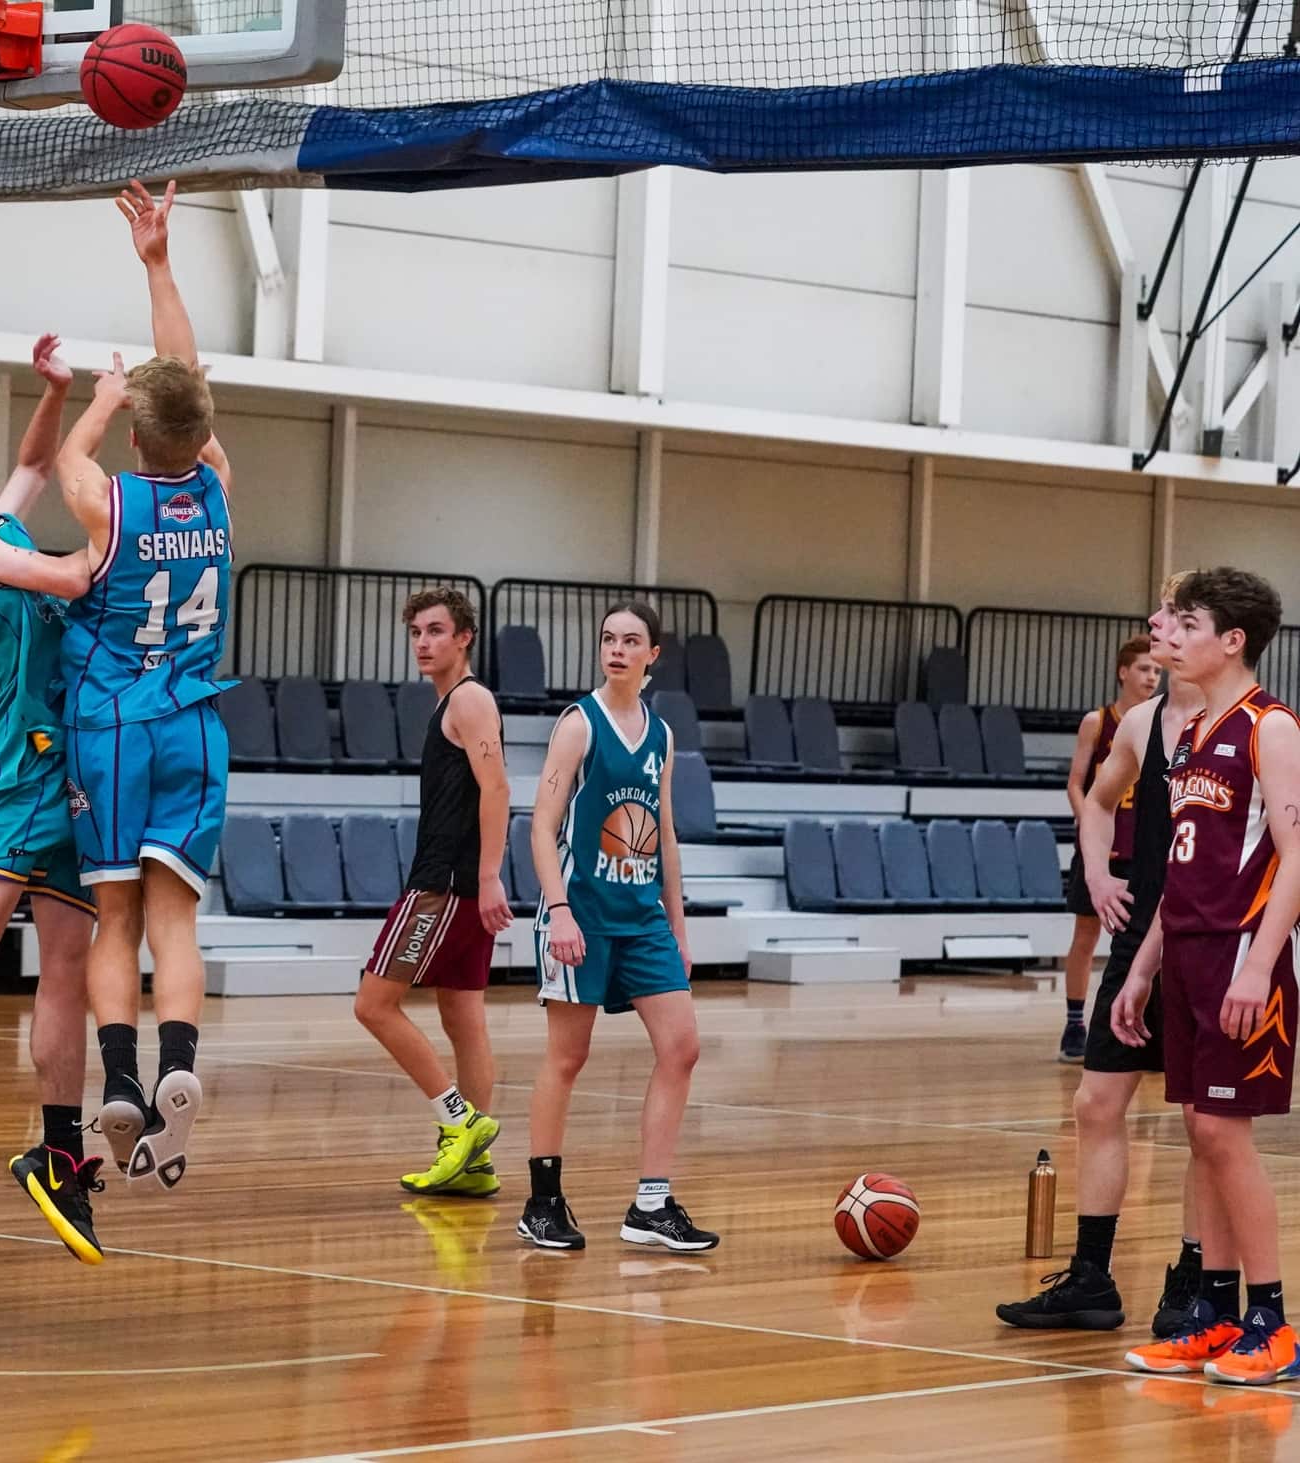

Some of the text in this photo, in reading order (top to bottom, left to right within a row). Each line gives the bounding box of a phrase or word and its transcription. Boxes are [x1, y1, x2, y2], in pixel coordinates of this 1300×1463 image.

[138, 528, 225, 562] SERVAAS
[133, 565, 220, 646] 14
[548, 769, 559, 795] 4
[606, 786, 660, 811] PARKDALE
[396, 913, 437, 964] VENOM
